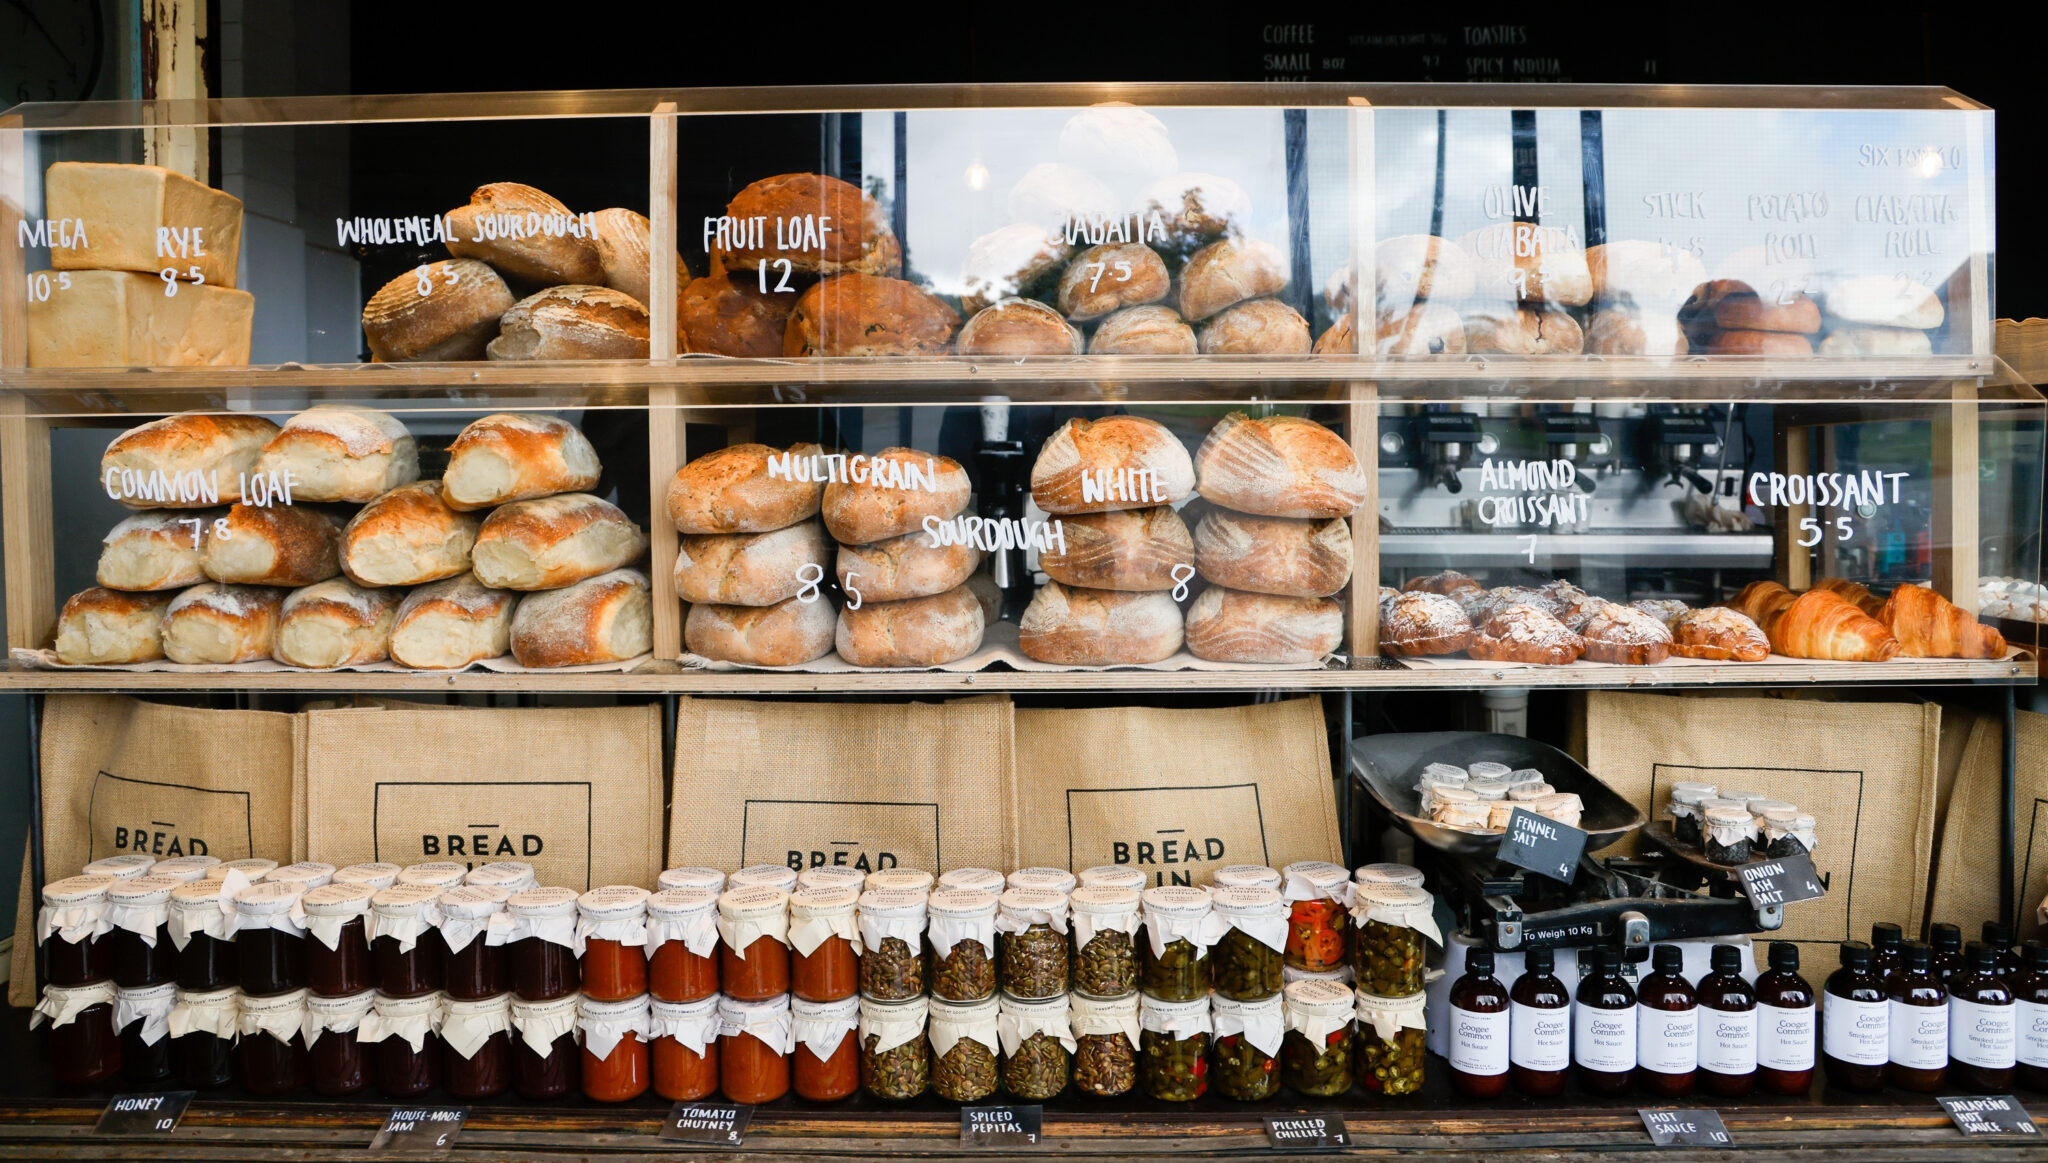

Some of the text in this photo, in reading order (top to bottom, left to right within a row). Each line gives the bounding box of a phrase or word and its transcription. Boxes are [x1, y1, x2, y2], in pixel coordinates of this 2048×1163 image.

[1263, 24, 1315, 45] COFFEE
[1464, 25, 1528, 46] TOASTIES
[1465, 57, 1504, 75] SPICY
[1857, 144, 1889, 168] SIX
[1484, 184, 1554, 220] OLIVE
[1642, 191, 1708, 220] STICK
[1747, 190, 1830, 224] POTATO
[1854, 193, 1960, 226] CIABATTA
[18, 218, 88, 250] MEGA
[336, 211, 600, 247] WHOLEMEAL SOURDOUGH
[703, 214, 832, 252] FRUIT LOAF
[156, 225, 205, 259] RYE
[1476, 224, 1579, 259] CIABATTA
[1764, 231, 1824, 266] ROLL
[1883, 228, 1944, 259] ROLL
[757, 258, 796, 294] 12
[767, 450, 938, 494] MULTIGRAIN
[1479, 458, 1576, 493] ALMOND
[105, 466, 300, 509] COMMON LOAF
[1080, 466, 1169, 504] WHITE
[1750, 469, 1910, 507] CROISSANT
[1477, 491, 1589, 528] CROISSANT
[921, 514, 1066, 556] SOURDOUGH
[1516, 533, 1540, 564] 7
[1169, 563, 1196, 603] 8
[1515, 815, 1558, 841] FENNEL
[115, 826, 209, 857] BREAD
[423, 833, 544, 857] BREAD
[1512, 830, 1538, 848] SALT
[1113, 836, 1225, 865] BREAD
[787, 850, 898, 874] BREAD
[1558, 863, 1569, 878] 4
[1743, 862, 1785, 882] ONION
[1749, 878, 1774, 894] ASH
[1806, 880, 1819, 894] 4
[1755, 890, 1784, 905] SALT
[1523, 925, 1593, 941] To Weigh 10 Kg
[1461, 1022, 1490, 1034] Coogee
[1537, 1021, 1564, 1032] Coogee
[1593, 1020, 1623, 1030] Coogee
[1667, 1022, 1693, 1032] Coogee
[1719, 1023, 1748, 1033] Coogee
[1779, 1019, 1807, 1029] Coogee
[1979, 1017, 2008, 1028] Coogee
[1458, 1028, 1492, 1040] Common
[1534, 1027, 1566, 1036] Common
[1590, 1027, 1625, 1036] Common
[1663, 1029, 1695, 1038] Common
[1716, 1029, 1750, 1039] Common
[1776, 1026, 1809, 1035] Common
[1537, 1038, 1548, 1046] Hot
[1594, 1038, 1604, 1046] Hot
[1968, 1034, 1994, 1044] Smoked
[114, 1096, 164, 1111] HONEY
[391, 1110, 462, 1121] HOUSE-MADE
[682, 1108, 736, 1119] TOMATO
[970, 1111, 1013, 1122] SPICED
[1648, 1112, 1677, 1123] HOT
[1955, 1111, 1983, 1122] HOT
[155, 1118, 173, 1130] 10
[385, 1121, 415, 1132] JAM
[676, 1119, 734, 1131] CHUTNEY
[971, 1122, 1022, 1133] PEPITAS
[1271, 1118, 1326, 1131] PICKLED
[1655, 1122, 1697, 1134] SAUCE
[1963, 1121, 2036, 1133] SAUCE 10
[436, 1133, 447, 1146] 6
[727, 1130, 738, 1141] 8
[1027, 1133, 1036, 1143] 7
[1275, 1128, 1327, 1139] CHILLIES
[1333, 1134, 1344, 1144] 7
[1709, 1131, 1728, 1143] 10
